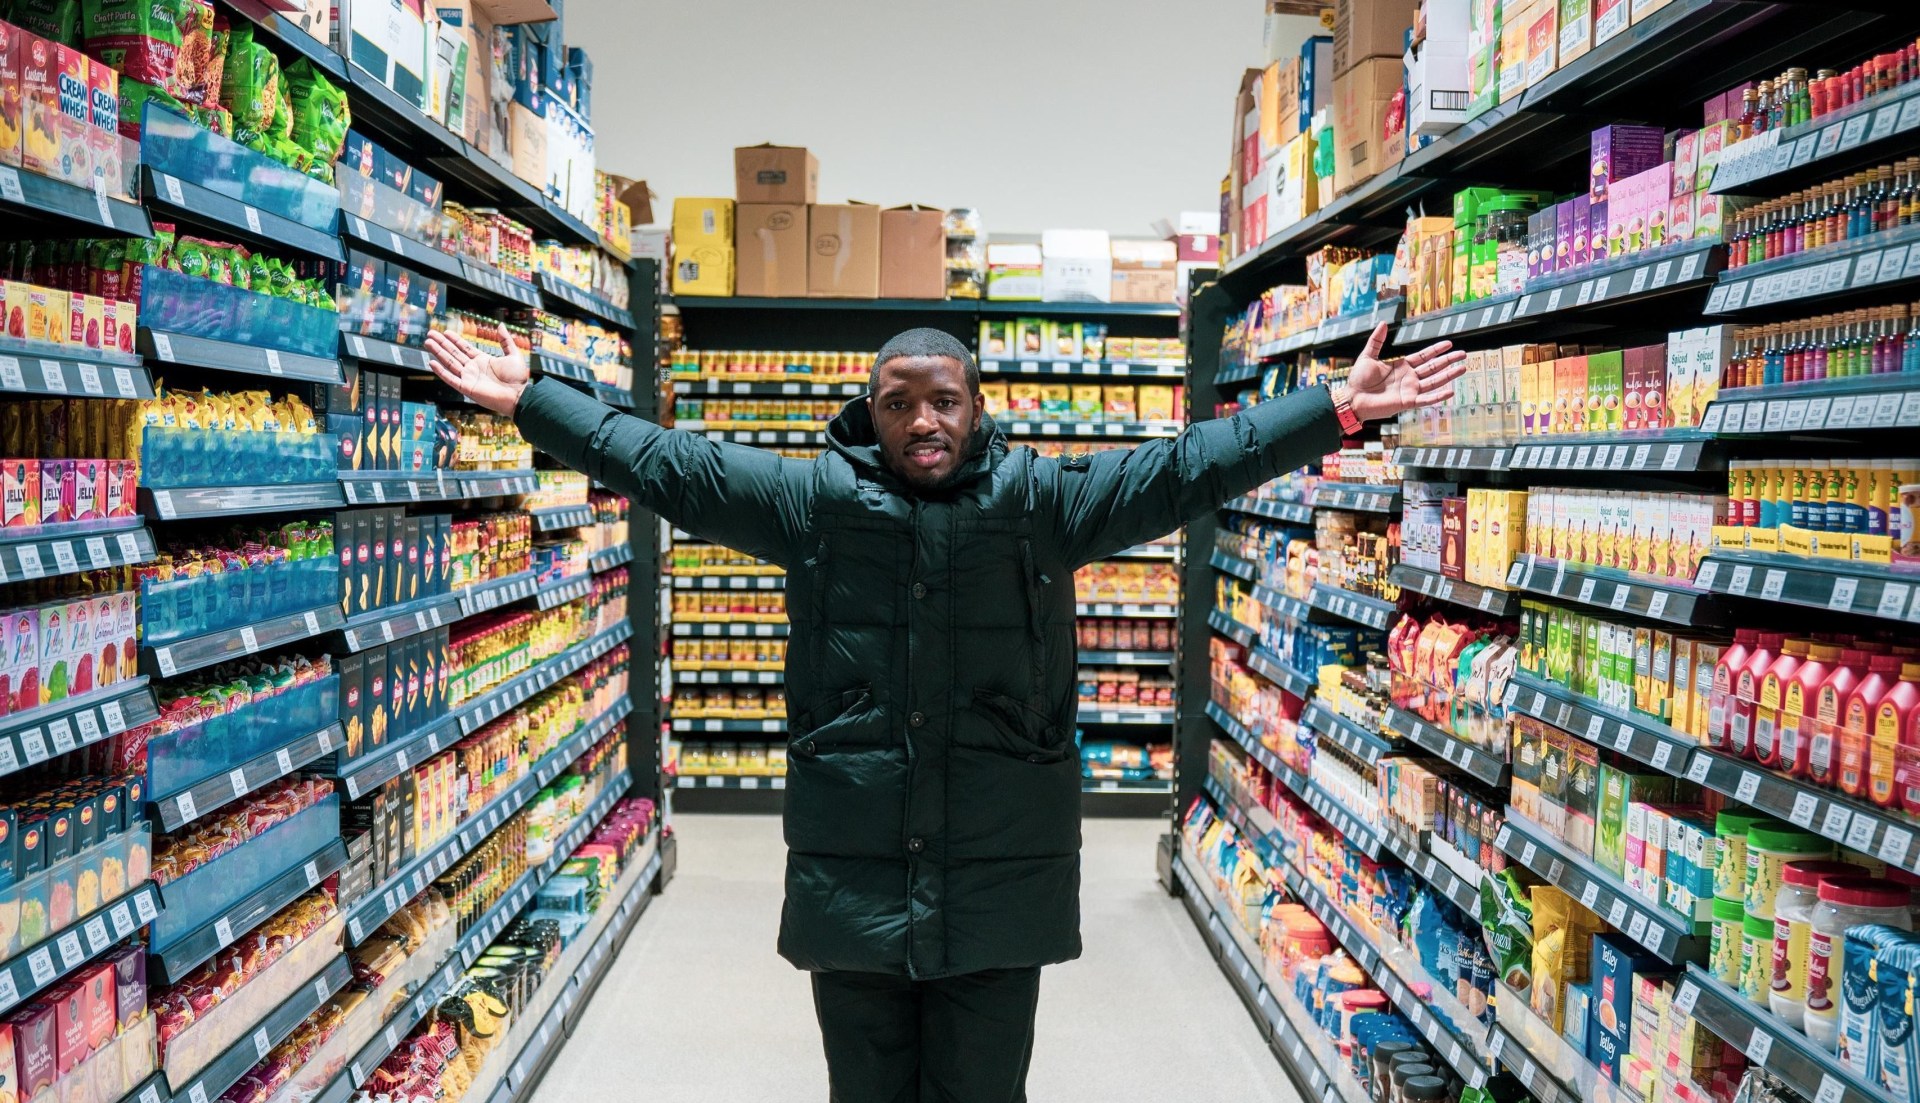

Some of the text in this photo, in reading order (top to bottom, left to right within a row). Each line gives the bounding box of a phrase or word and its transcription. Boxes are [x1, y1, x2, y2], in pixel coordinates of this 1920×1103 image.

[25, 66, 47, 82] Custard
[59, 73, 88, 102] CREAM
[60, 95, 88, 120] WHEAT
[92, 88, 117, 115] CREAM
[92, 109, 117, 134] WHEAT
[1671, 353, 1688, 365] Spiced
[1696, 350, 1714, 362] Spiced
[1677, 366, 1685, 375] Tea
[1702, 362, 1711, 372] Tea
[7, 488, 26, 503] JELLY
[44, 488, 62, 502] JELLY
[78, 487, 96, 500] JELLY
[109, 485, 124, 498] JELLY
[1600, 505, 1612, 518] Spiced
[1617, 506, 1629, 518] Spiced
[1616, 660, 1629, 673] DIGEST
[1602, 944, 1618, 973] Tetley
[1599, 1030, 1616, 1060] Tetley
